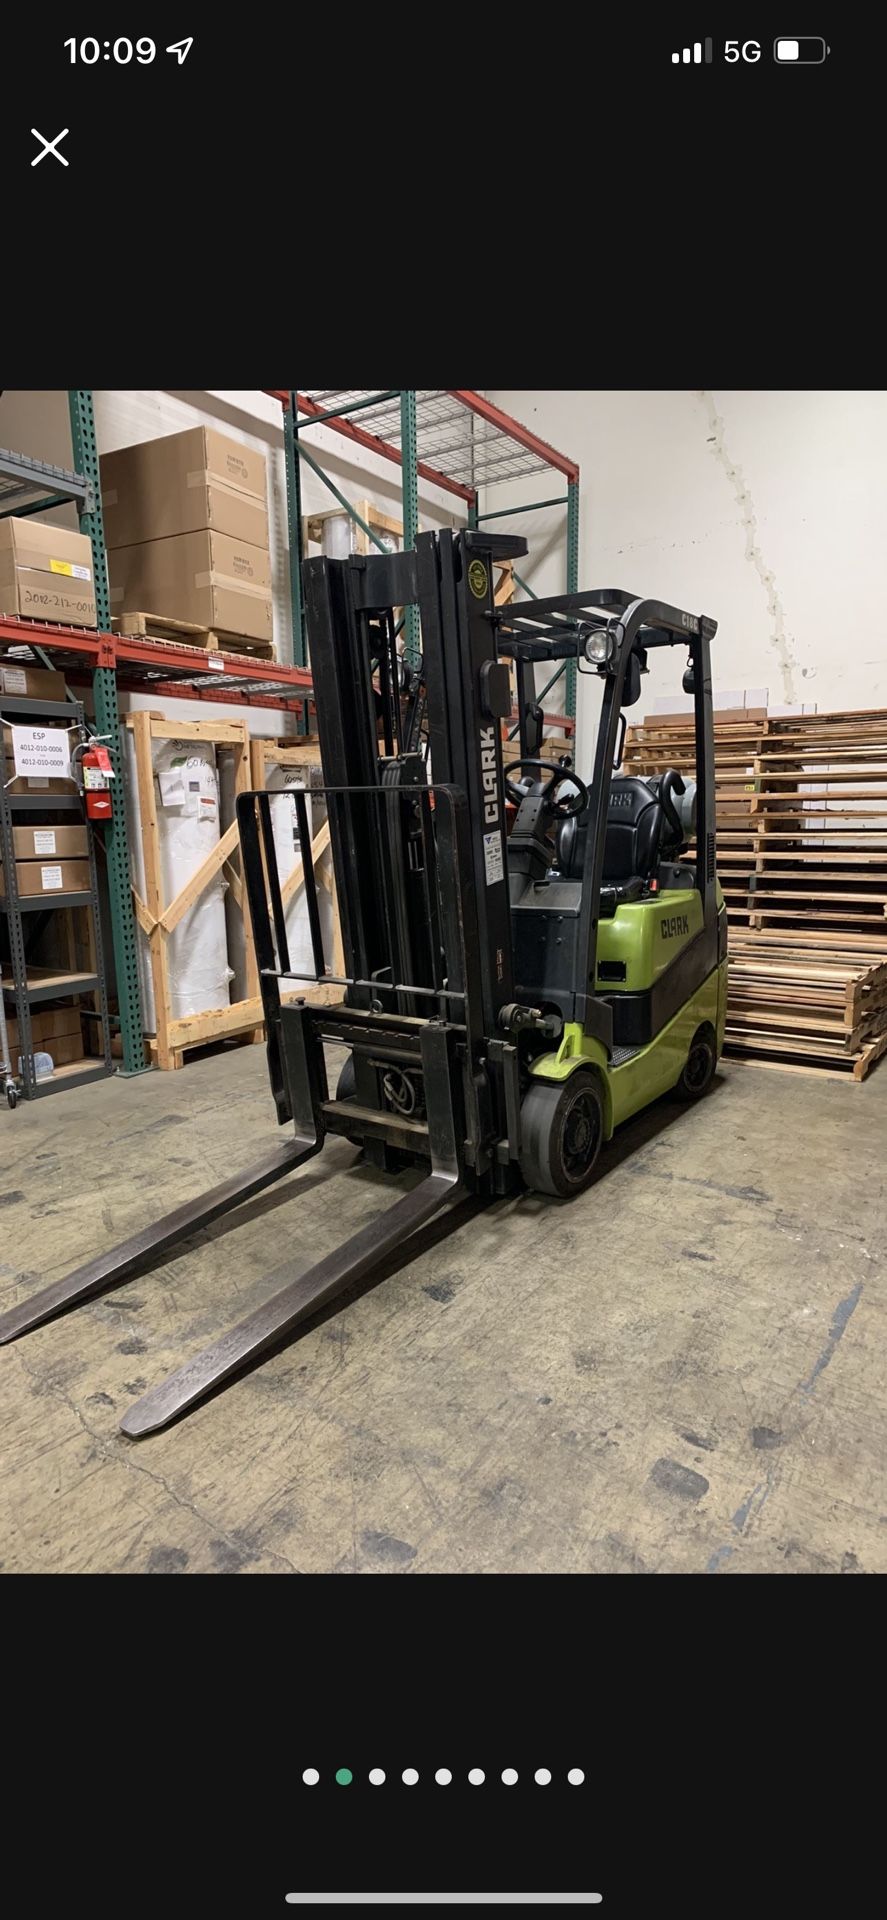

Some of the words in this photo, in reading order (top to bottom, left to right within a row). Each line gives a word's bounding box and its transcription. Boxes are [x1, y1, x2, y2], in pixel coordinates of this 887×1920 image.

[33, 732, 46, 740] ESP
[480, 726, 499, 824] CLARK
[660, 914, 689, 939] CLARK
